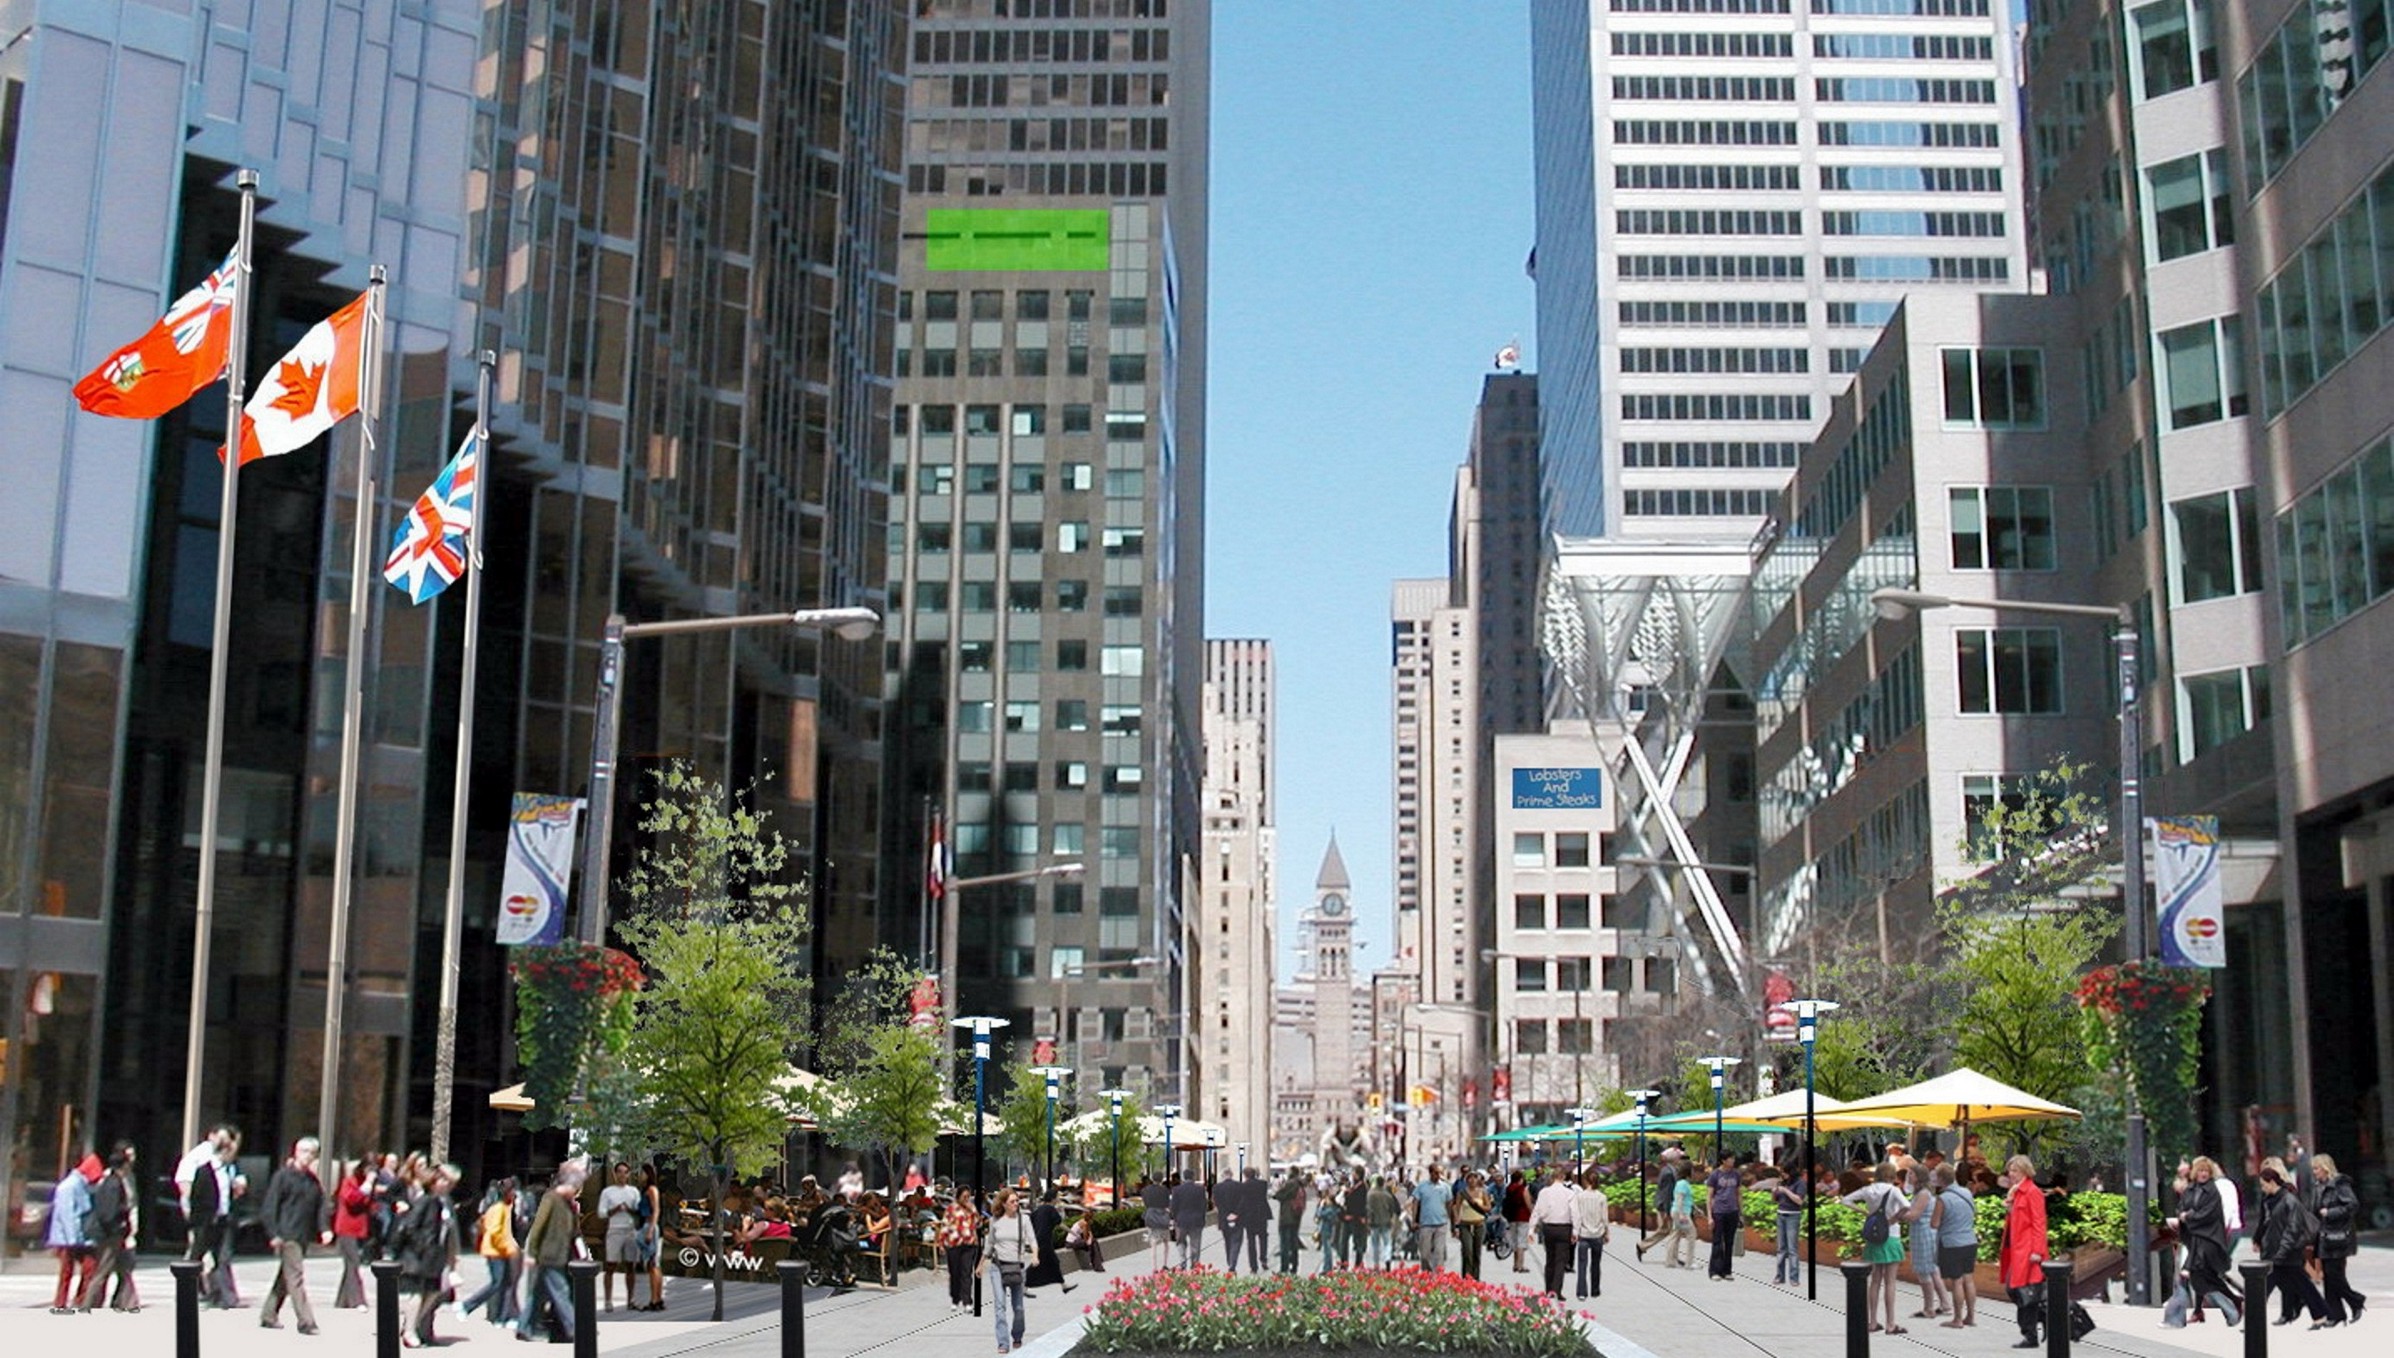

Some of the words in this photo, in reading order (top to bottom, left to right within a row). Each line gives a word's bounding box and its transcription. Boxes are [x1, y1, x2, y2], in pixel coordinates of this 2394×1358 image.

[1528, 768, 1582, 782] Lobsters
[1543, 781, 1570, 793] And
[1517, 795, 1553, 807] Prime
[1556, 793, 1597, 806] Steaks
